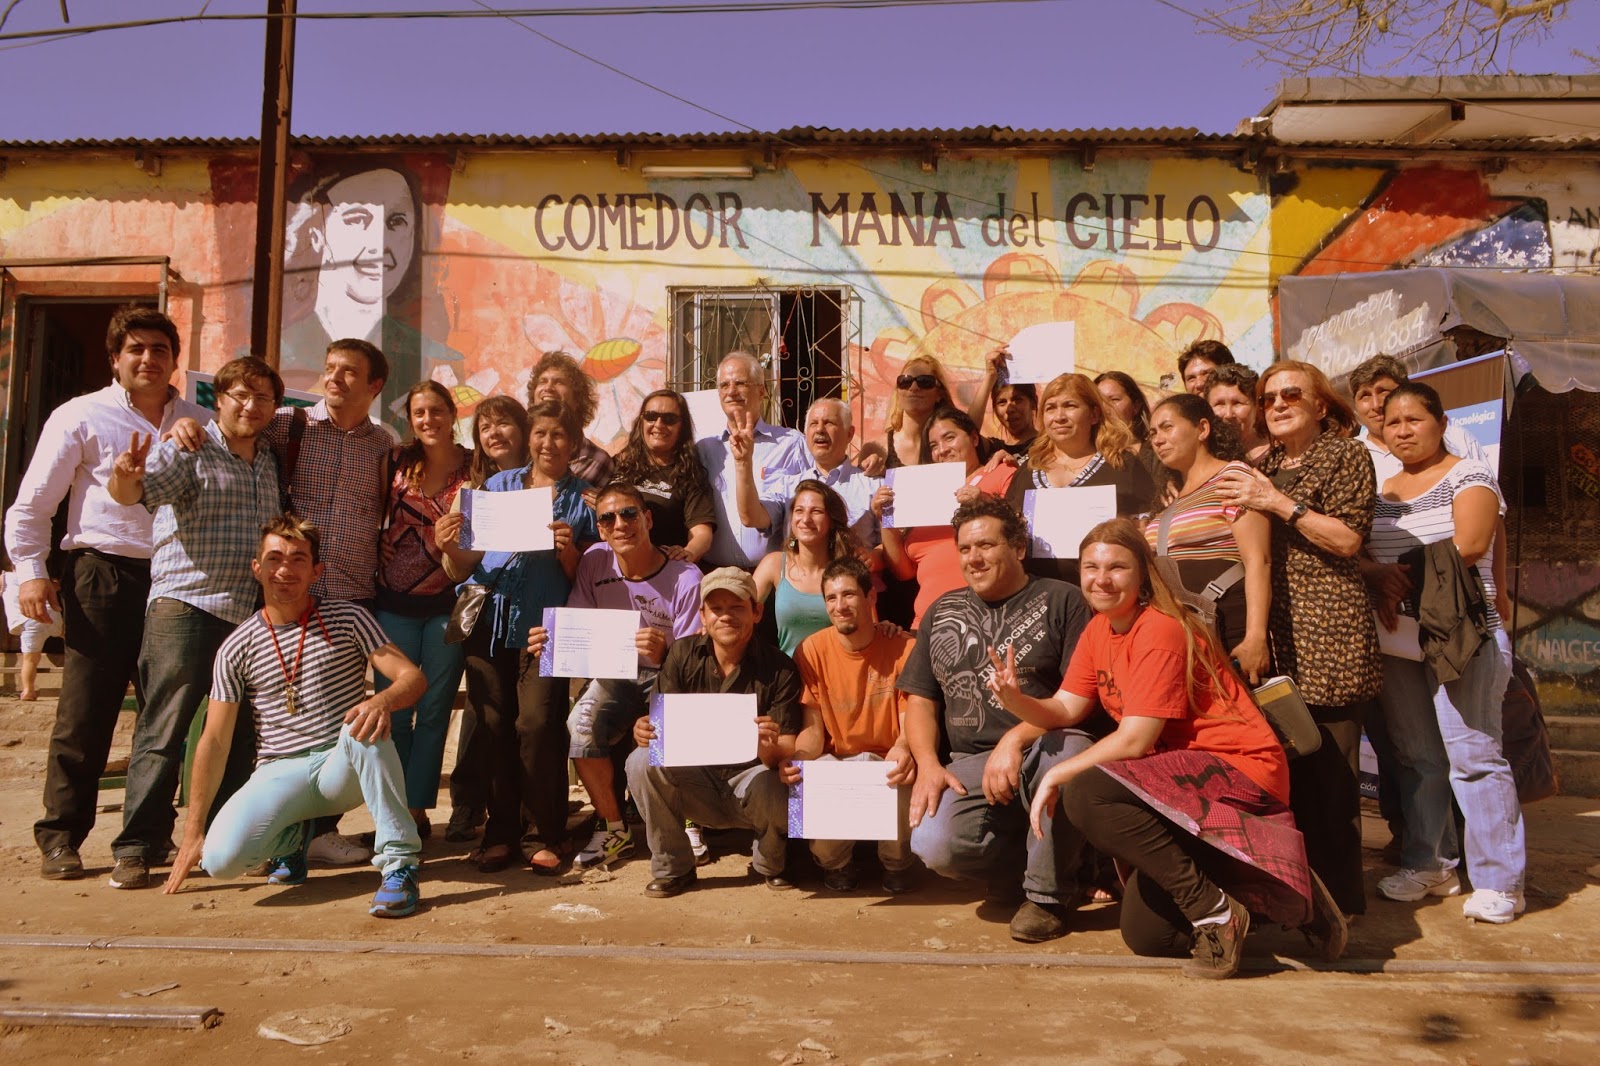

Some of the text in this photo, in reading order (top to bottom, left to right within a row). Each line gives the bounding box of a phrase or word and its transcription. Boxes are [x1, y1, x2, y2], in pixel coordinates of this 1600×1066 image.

[535, 192, 1221, 253] COMEDOR MANA del CIELO
[1451, 410, 1496, 428] Tecnológica
[996, 604, 1048, 660] PROGRESS
